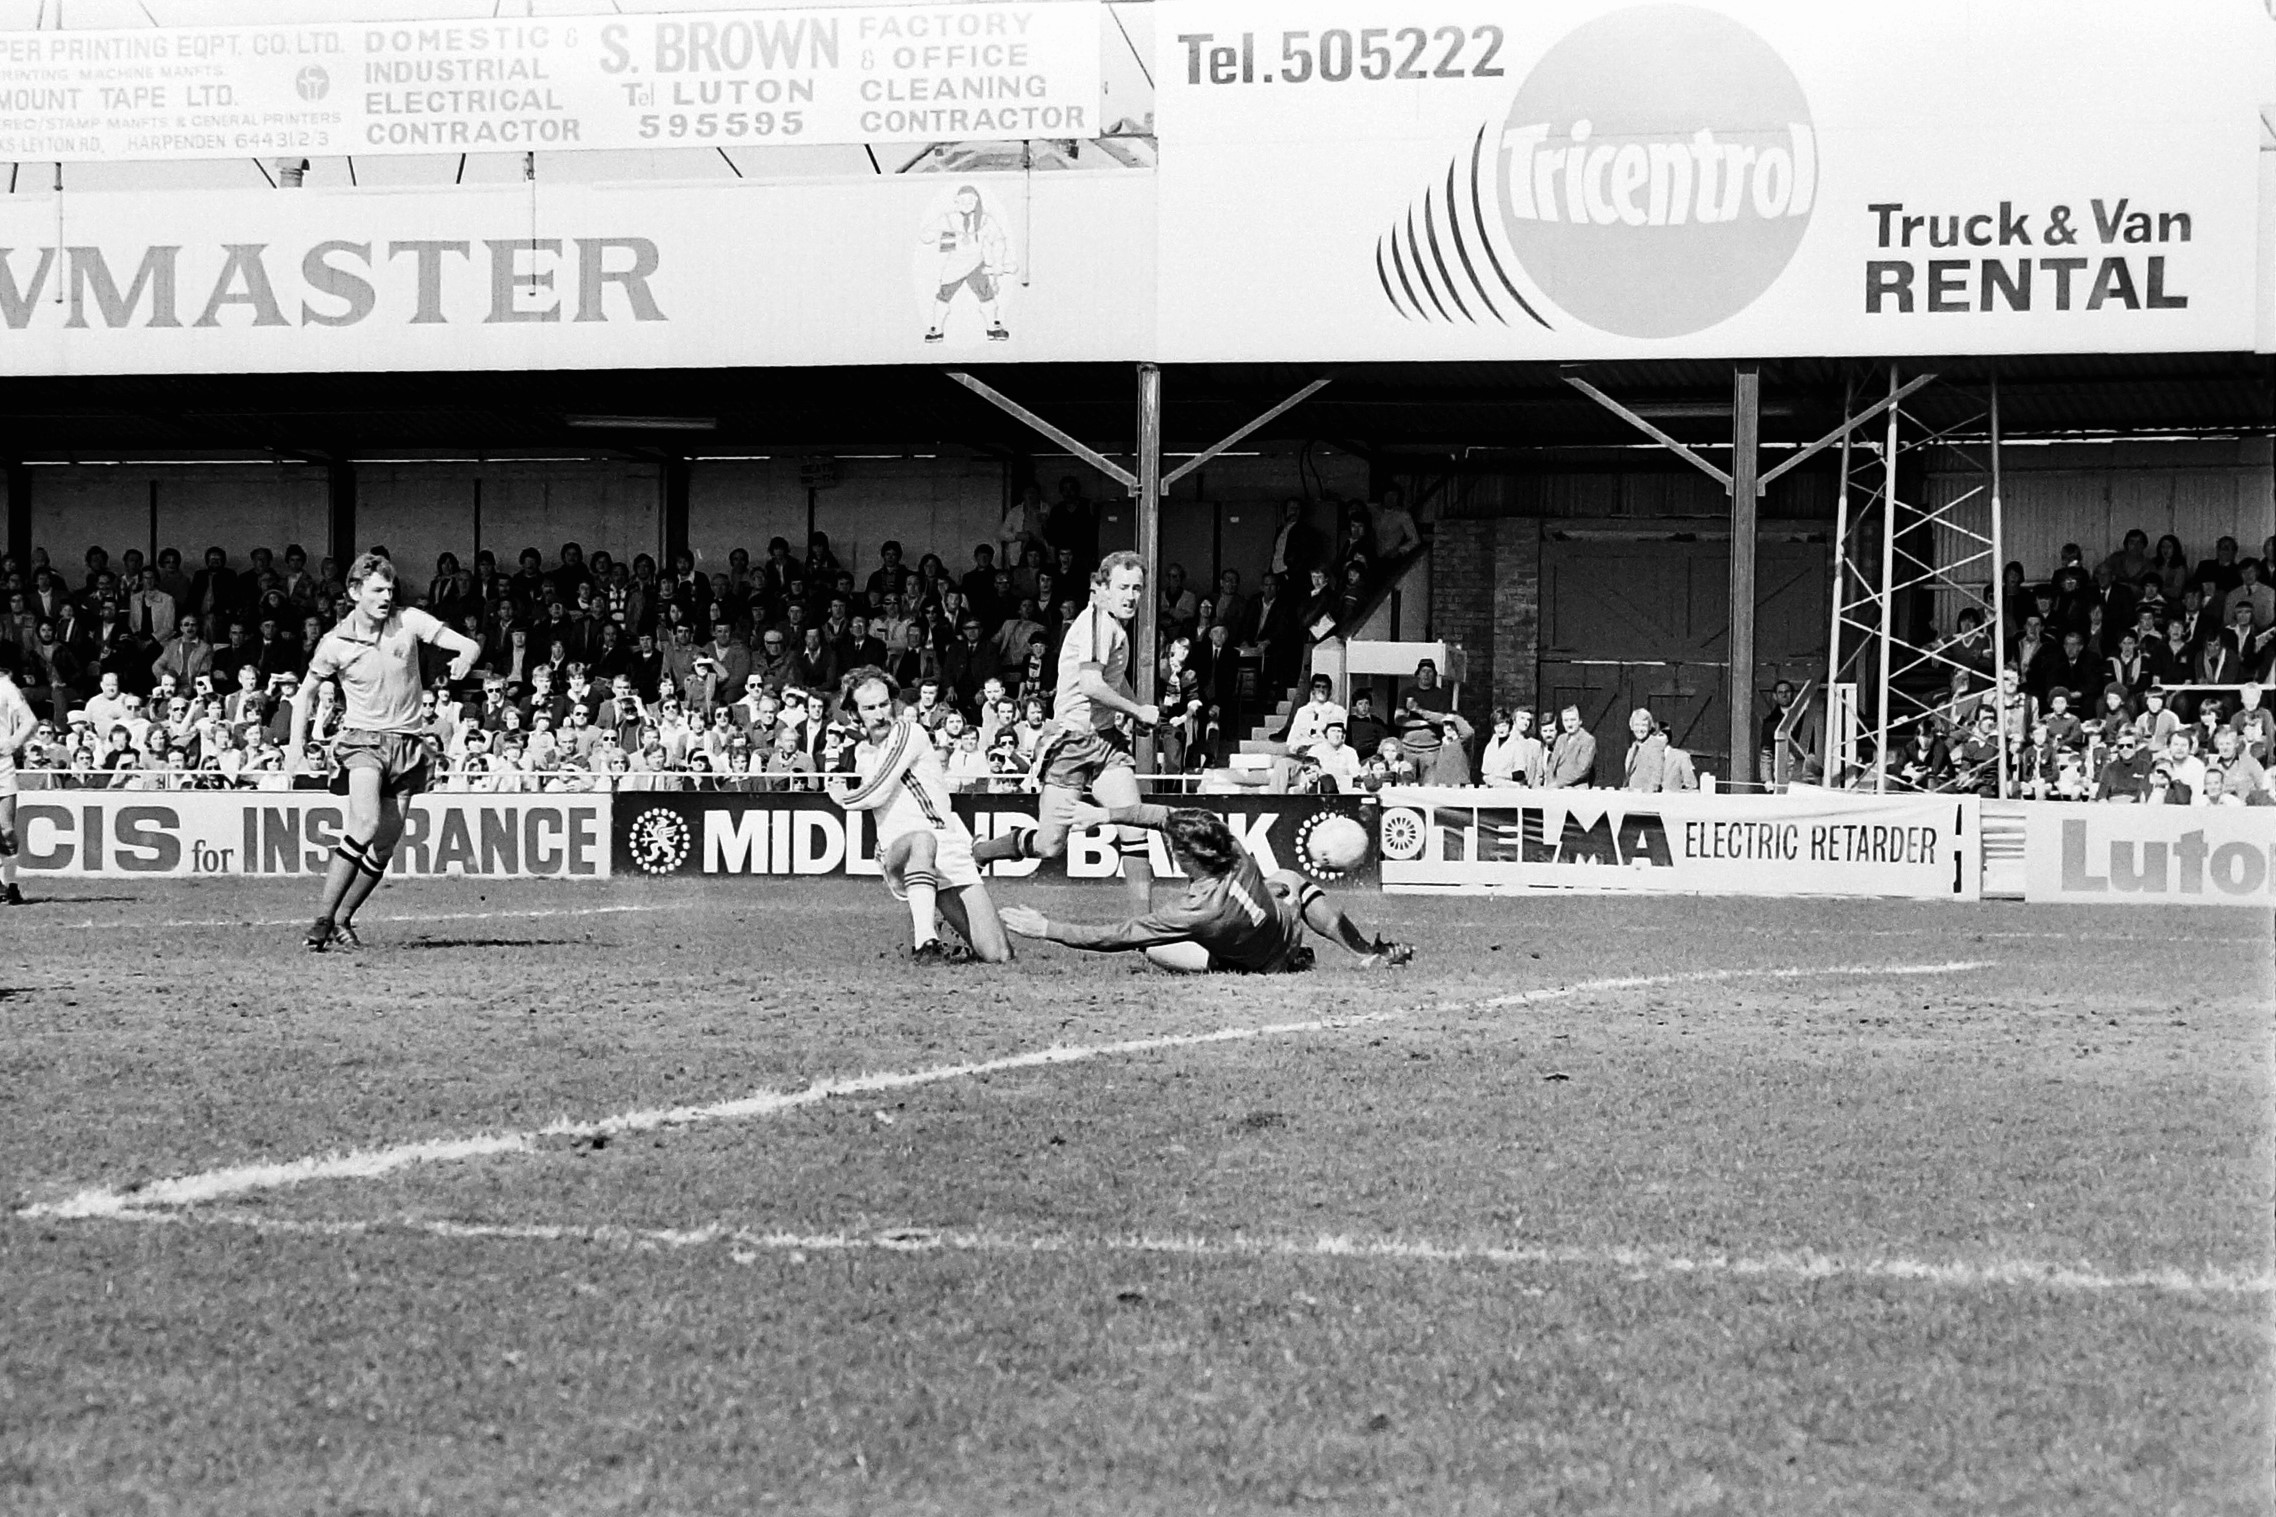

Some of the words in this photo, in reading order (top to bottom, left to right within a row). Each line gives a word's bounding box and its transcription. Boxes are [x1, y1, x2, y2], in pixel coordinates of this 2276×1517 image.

[364, 26, 550, 54] DOMESTIC
[858, 12, 1034, 40] FACTORY
[51, 35, 169, 61] PRINTING
[297, 31, 345, 56] LTD.
[600, 23, 639, 75] S.
[655, 17, 839, 73] BROWN
[892, 44, 1028, 70] OFFICE
[364, 58, 550, 84] INDUSTRIAL
[99, 85, 166, 110] TAPE
[187, 84, 239, 107] LTD.
[365, 88, 564, 115] ELECTRICAL
[673, 78, 814, 105] LUTON
[860, 75, 1047, 102] CLEANING
[191, 113, 259, 128] GENERAL
[263, 111, 342, 126] PRINTERS
[366, 118, 581, 145] CONTRACTOR
[638, 111, 804, 139] 595595
[859, 105, 1085, 133] CONTRACTOR
[128, 133, 226, 151] HARPENDEN
[1501, 118, 1816, 226] Tricentrol
[1867, 200, 2033, 249] Truck
[2042, 204, 2079, 246] &
[2089, 197, 2193, 244] Van
[1865, 255, 2189, 314] RENTAL
[15, 804, 182, 873] CIS
[191, 839, 235, 874] for
[242, 806, 597, 877] INSRANCE
[703, 808, 1044, 877] MIDLD
[1066, 803, 1280, 879] BAK
[1433, 806, 1675, 868] TELMA
[1685, 821, 1799, 861] ELECTRIC
[1810, 824, 1938, 865] RETARDER
[2061, 809, 2276, 896] Luto
